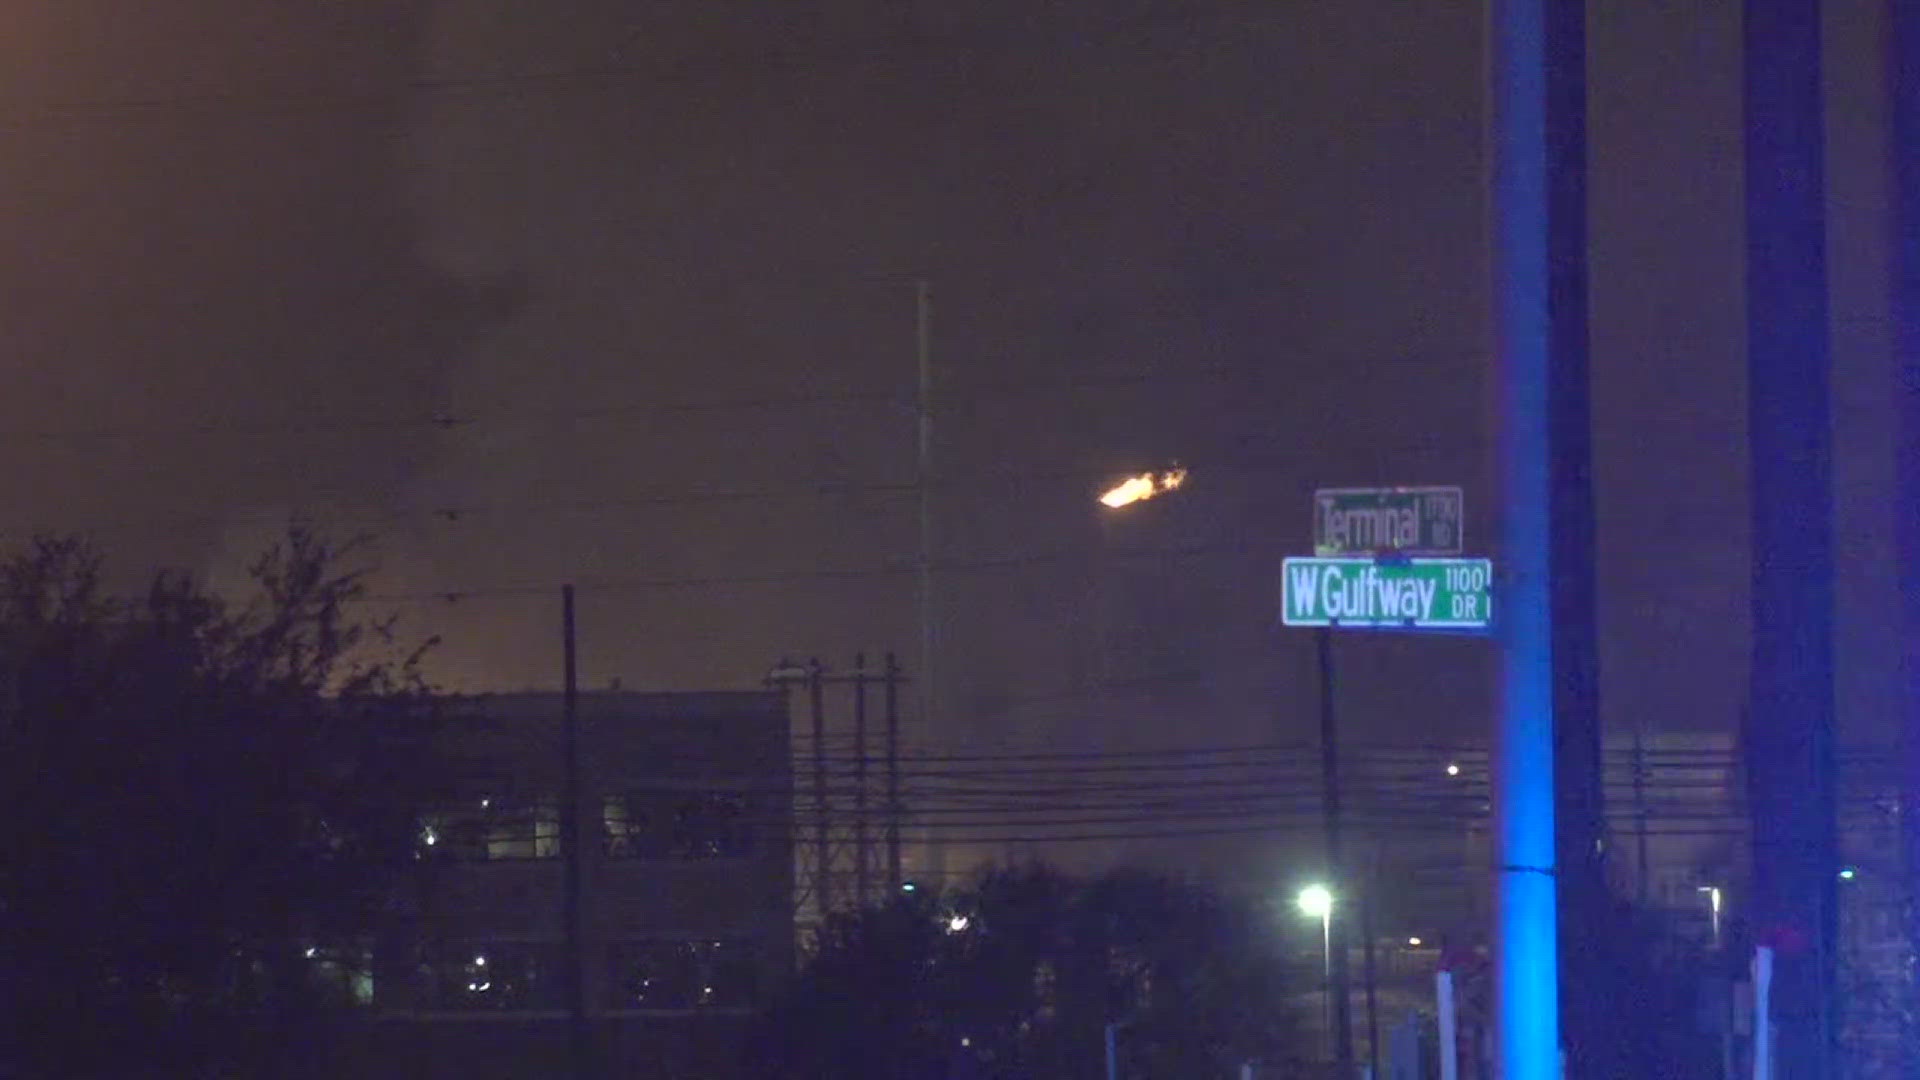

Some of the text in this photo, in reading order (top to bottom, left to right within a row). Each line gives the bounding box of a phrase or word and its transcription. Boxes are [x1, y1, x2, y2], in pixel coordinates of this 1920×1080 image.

[1319, 496, 1419, 546] Terminal
[1291, 565, 1436, 620] W Gulfway
[1446, 567, 1484, 592] 1100
[1452, 594, 1477, 618] DR
